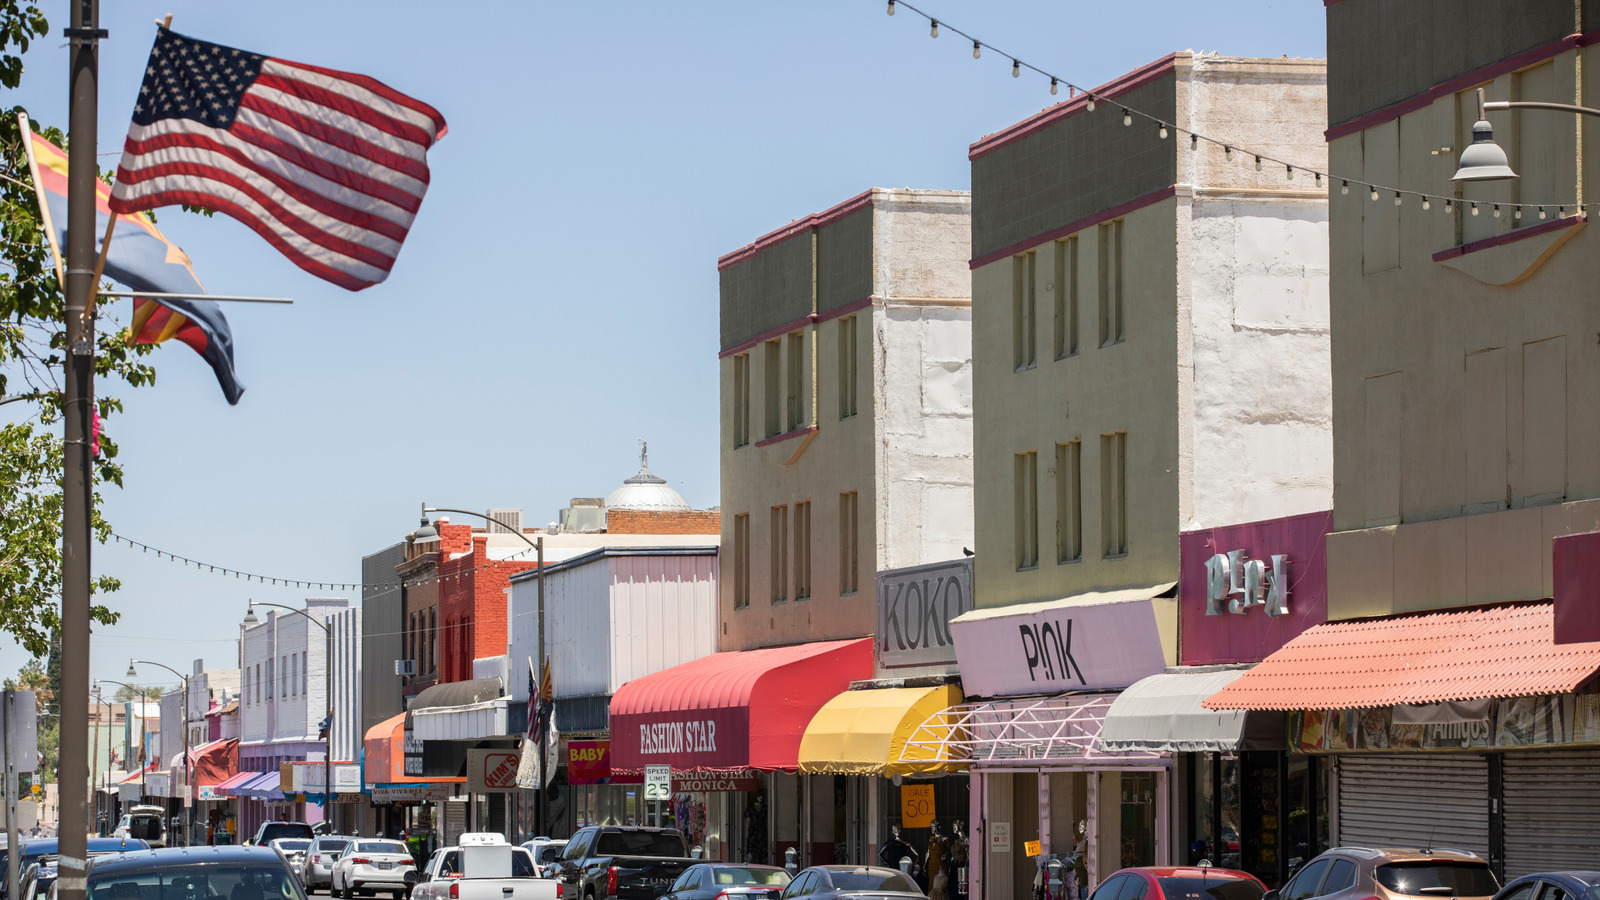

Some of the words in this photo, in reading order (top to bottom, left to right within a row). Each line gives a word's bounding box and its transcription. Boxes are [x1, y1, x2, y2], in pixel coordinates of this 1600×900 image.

[883, 576, 963, 652] KOKO
[640, 722, 684, 754] FASHION
[686, 720, 717, 753] STAR
[570, 748, 605, 761] BABY
[486, 755, 517, 785] KIM'S
[671, 769, 716, 781] ASHION
[500, 769, 517, 787] SHOES
[647, 783, 669, 796] 25
[680, 780, 737, 792] MONICA
[908, 788, 930, 797] SALE
